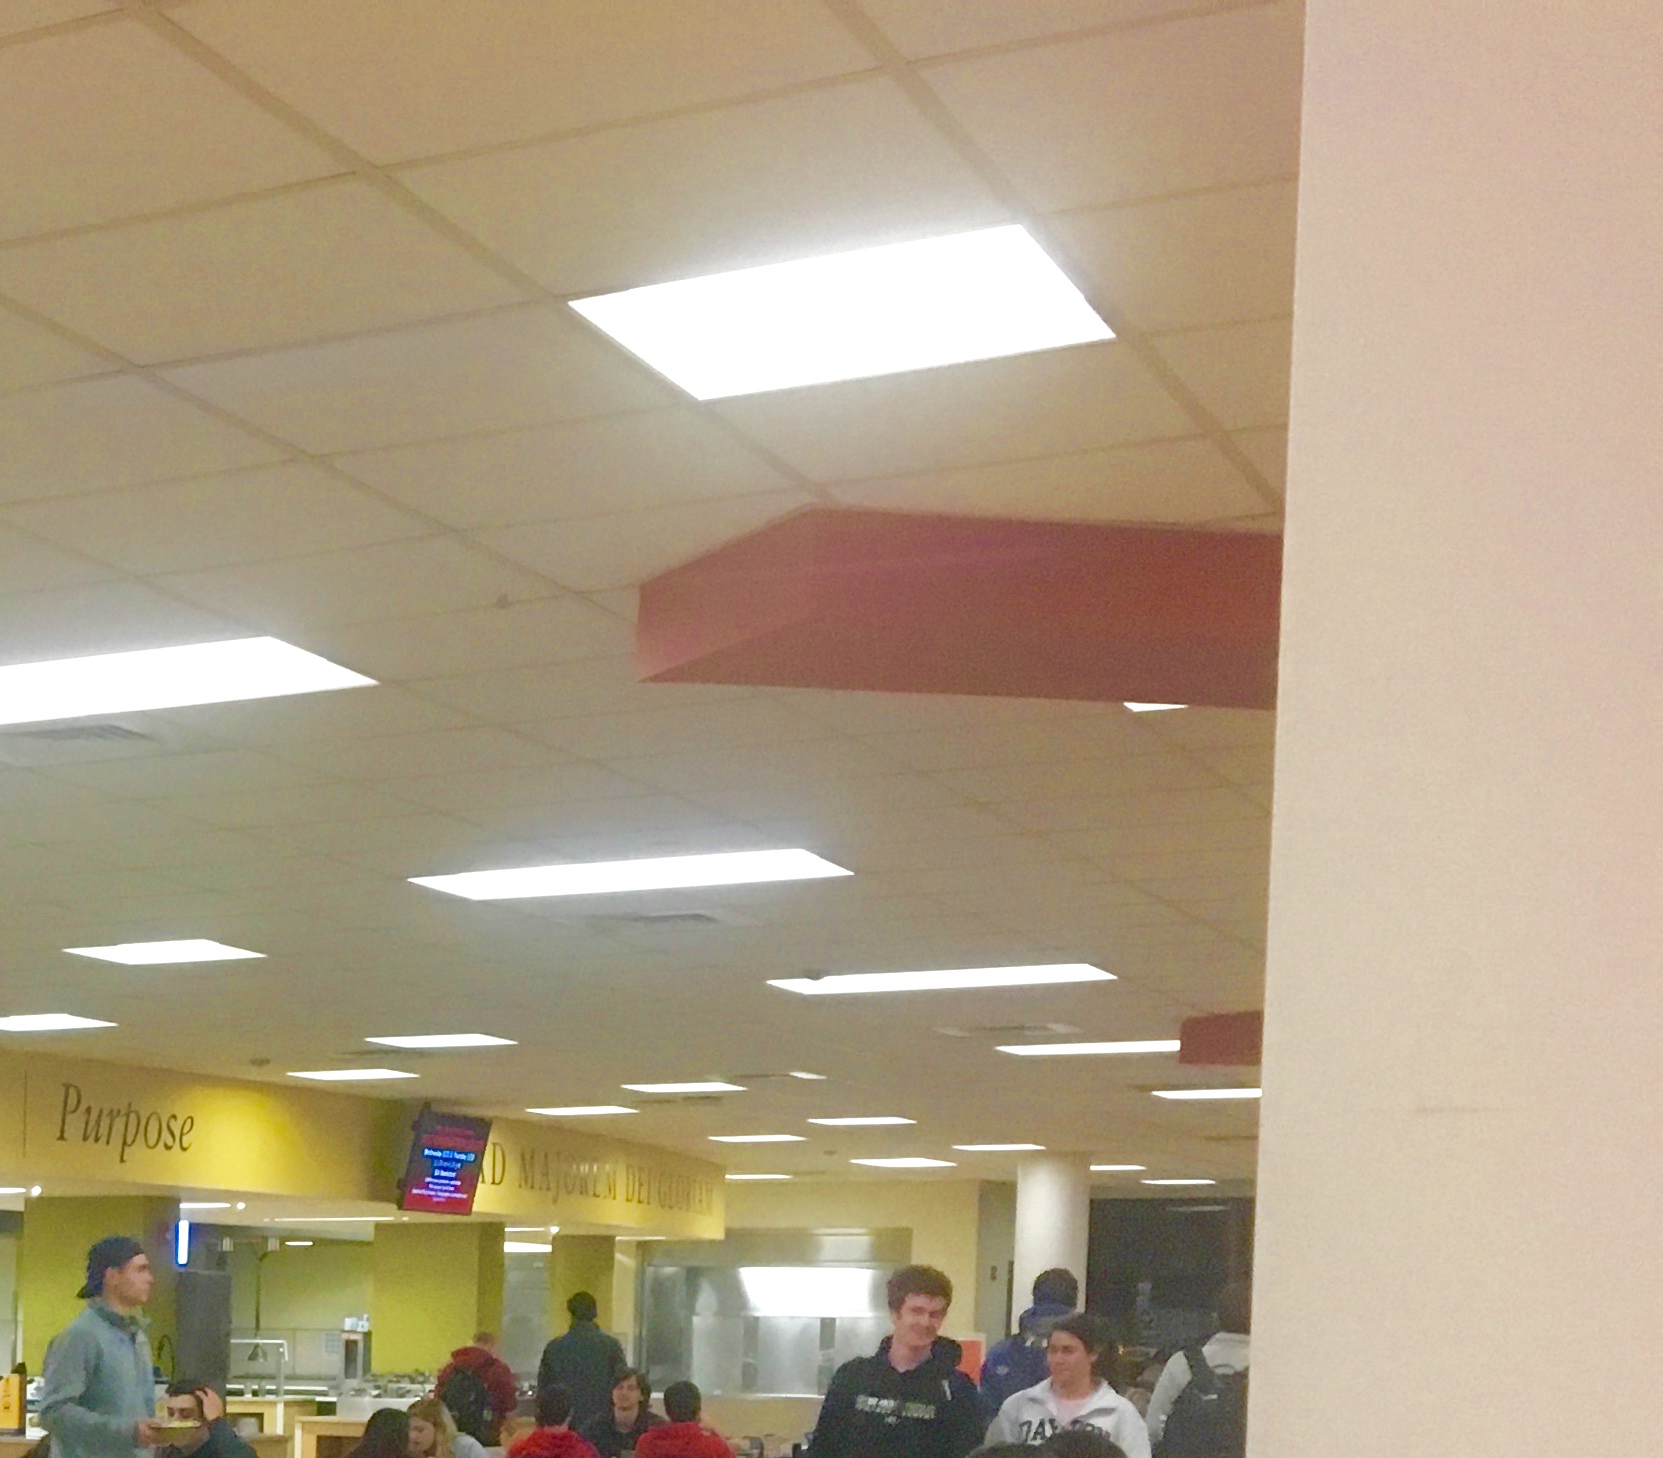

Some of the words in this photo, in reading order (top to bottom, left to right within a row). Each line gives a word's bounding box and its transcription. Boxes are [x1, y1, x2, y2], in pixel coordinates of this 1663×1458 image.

[56, 1082, 194, 1163] Purpose
[518, 1149, 617, 1204] MAJOREM
[625, 1163, 651, 1205] DEI
